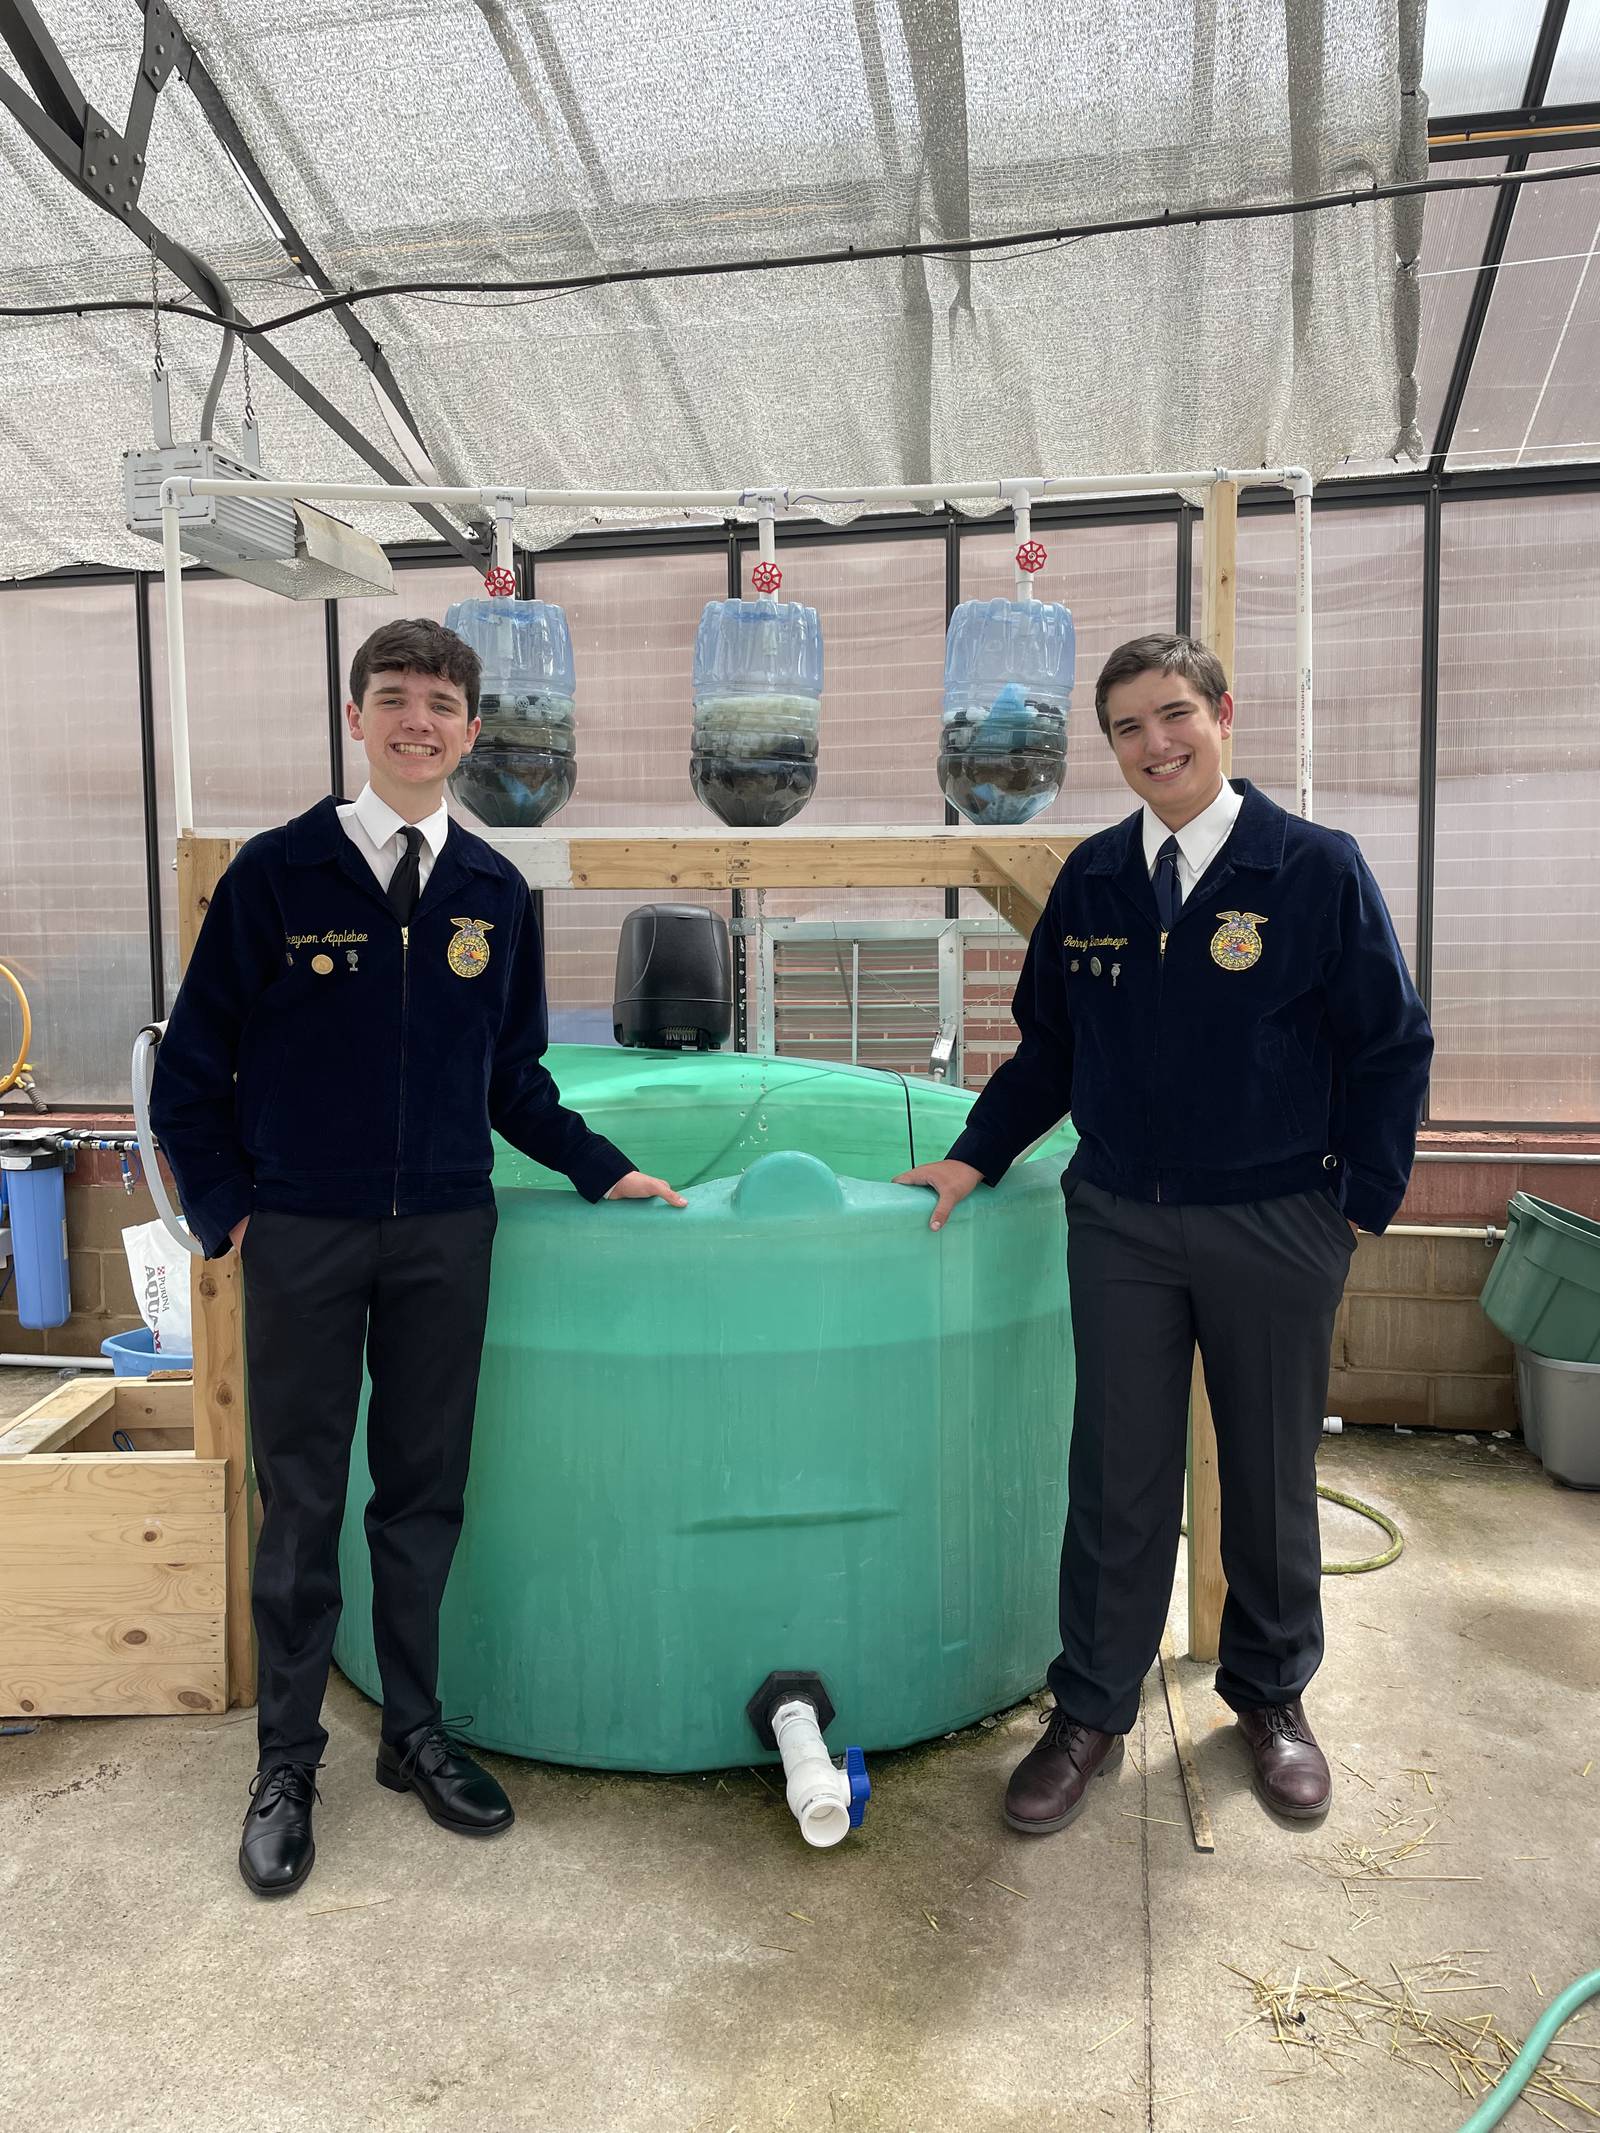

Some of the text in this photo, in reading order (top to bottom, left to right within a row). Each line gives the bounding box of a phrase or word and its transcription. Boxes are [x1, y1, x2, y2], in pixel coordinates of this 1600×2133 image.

[321, 930, 368, 948] Applebee
[144, 1265, 161, 1354] AQUAM
[157, 1276, 170, 1312] PURINA
